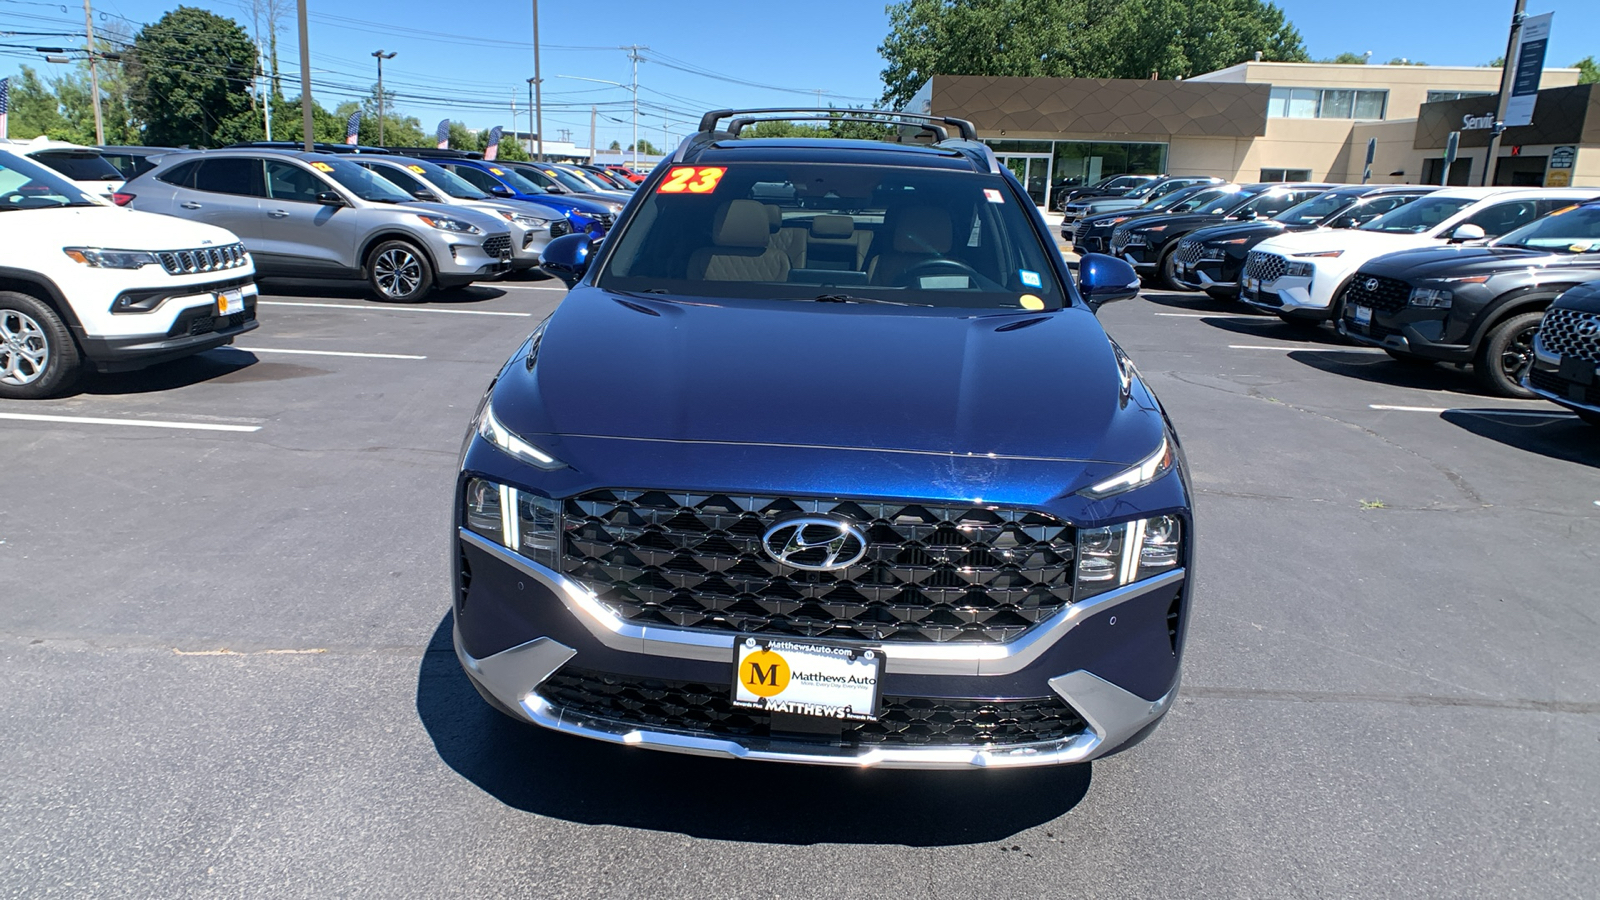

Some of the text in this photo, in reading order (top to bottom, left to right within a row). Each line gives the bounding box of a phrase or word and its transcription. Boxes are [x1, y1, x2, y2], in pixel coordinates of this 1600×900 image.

[1461, 112, 1495, 130] Servic
[660, 167, 724, 193] 23
[768, 640, 853, 656] MatthewsAuto.com
[747, 661, 781, 687] M
[791, 670, 877, 685] Matthews Auto
[765, 700, 846, 719] MATTHEWS
